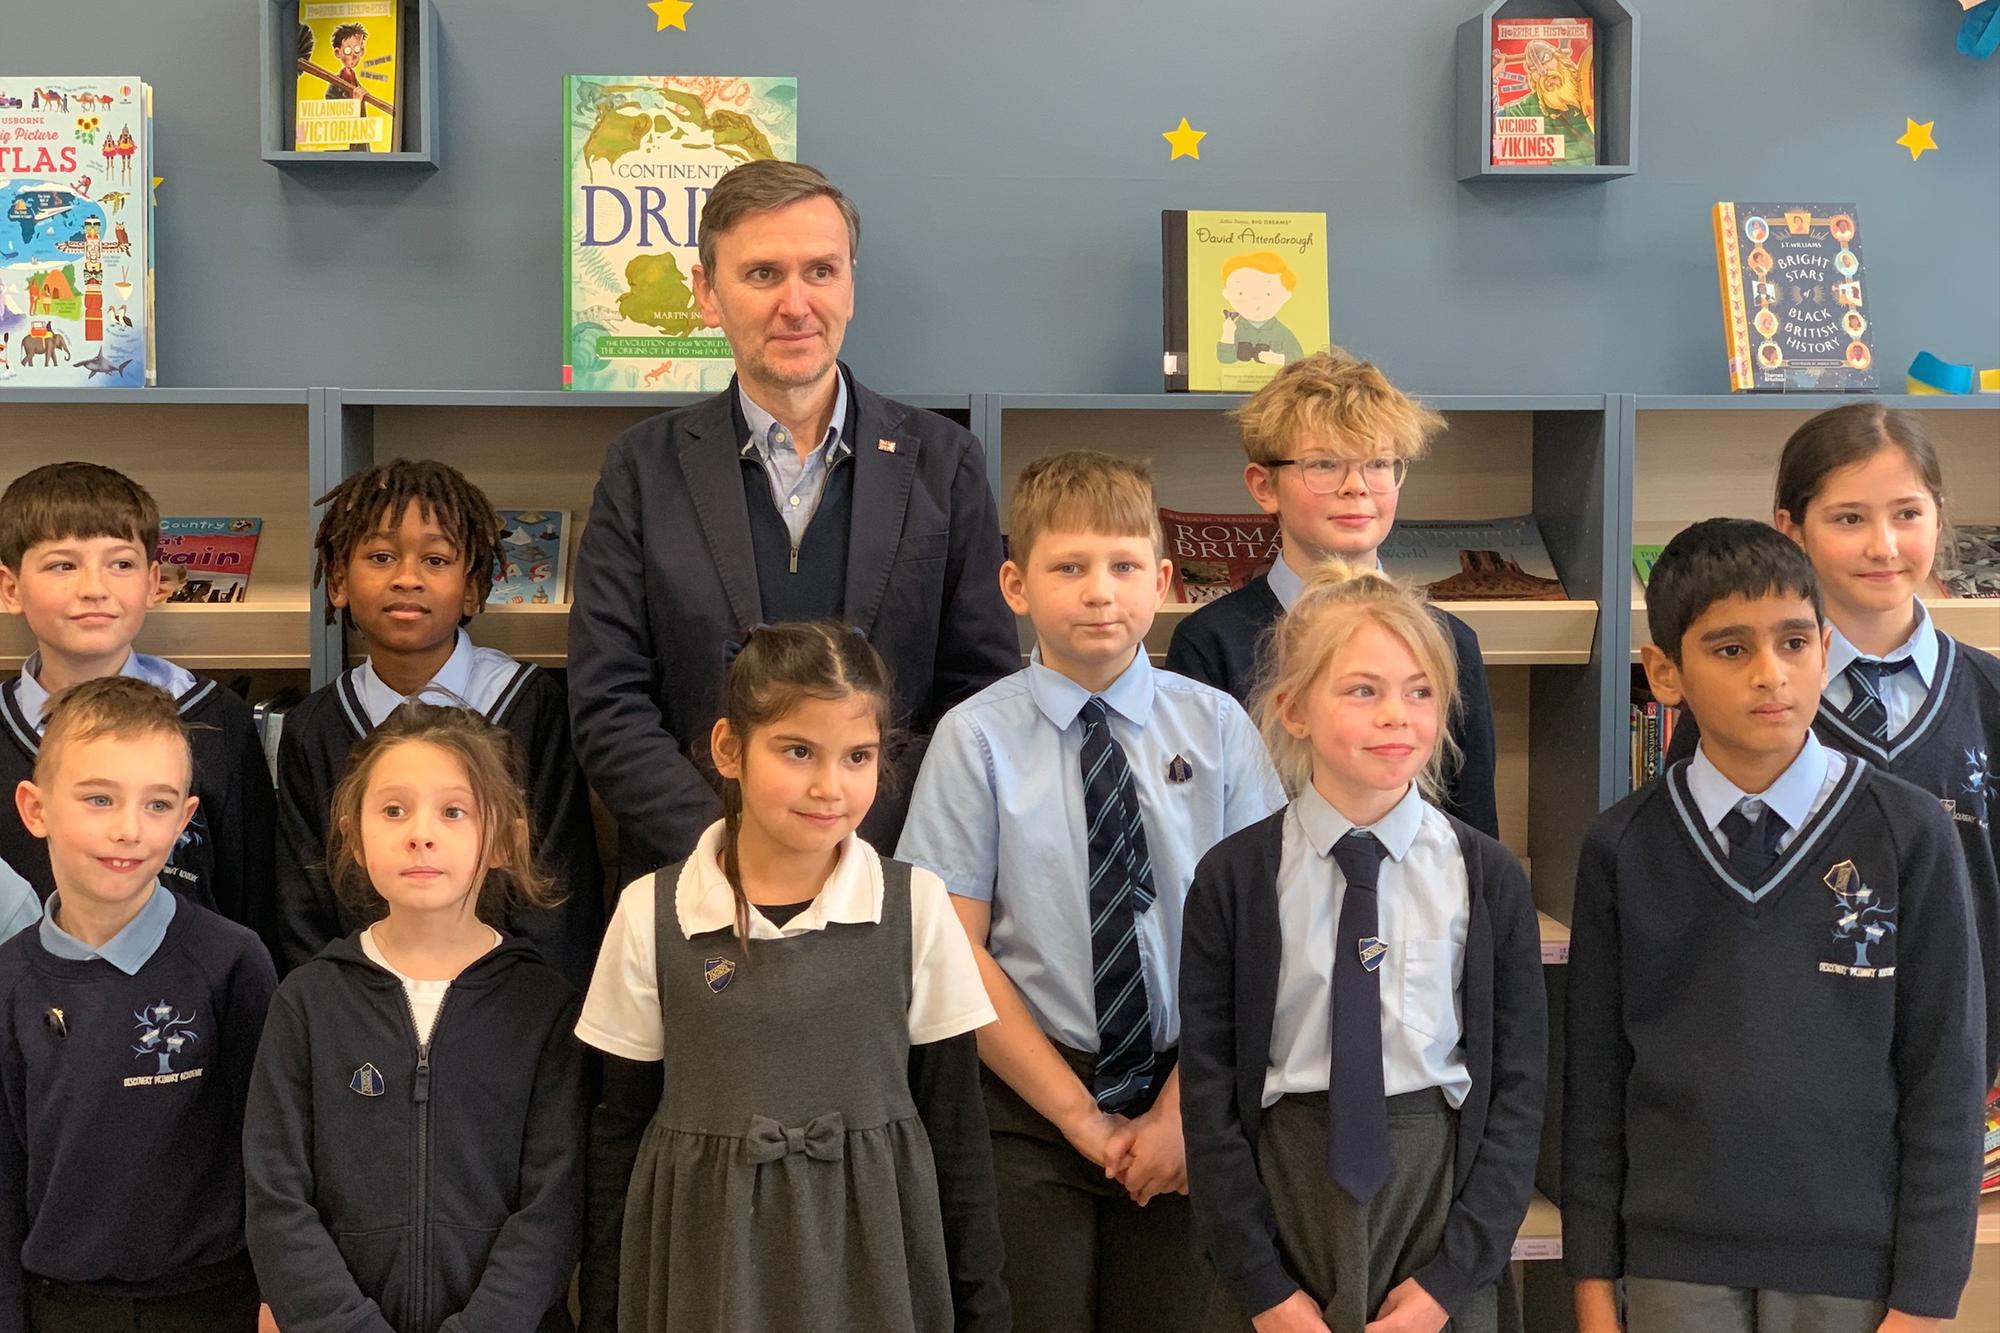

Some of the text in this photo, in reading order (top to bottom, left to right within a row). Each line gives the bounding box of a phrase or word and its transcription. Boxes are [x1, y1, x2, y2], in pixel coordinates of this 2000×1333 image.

[301, 101, 354, 117] VILLAINOUS
[1, 117, 45, 125] USBORNE
[1498, 119, 1537, 133] VICIOUS
[14, 127, 59, 141] Picture
[302, 119, 376, 142] VICTORIANS
[1501, 137, 1555, 157] VIKINGS
[0, 147, 77, 173] TLAS
[618, 163, 738, 180] CONTINENTA
[580, 185, 712, 248] DRI
[1196, 227, 1314, 254] David Attenborough
[1777, 253, 1830, 270] BRIGHT
[1785, 269, 1824, 282] STARS
[1803, 288, 1810, 299] of
[653, 311, 702, 320] MARTIN IN
[1788, 307, 1832, 323] BLACK
[1784, 321, 1839, 339] BRITISH
[617, 347, 648, 355] ORIGINS
[620, 339, 666, 347] EVOLUTION
[694, 339, 724, 347] WORLD
[1786, 336, 1841, 354] HISTORY
[160, 520, 225, 530] Country
[1175, 524, 1282, 542] ROMA
[1394, 529, 1535, 548] ONDERFUL
[155, 546, 241, 567] tain
[1174, 539, 1282, 558] BRITA
